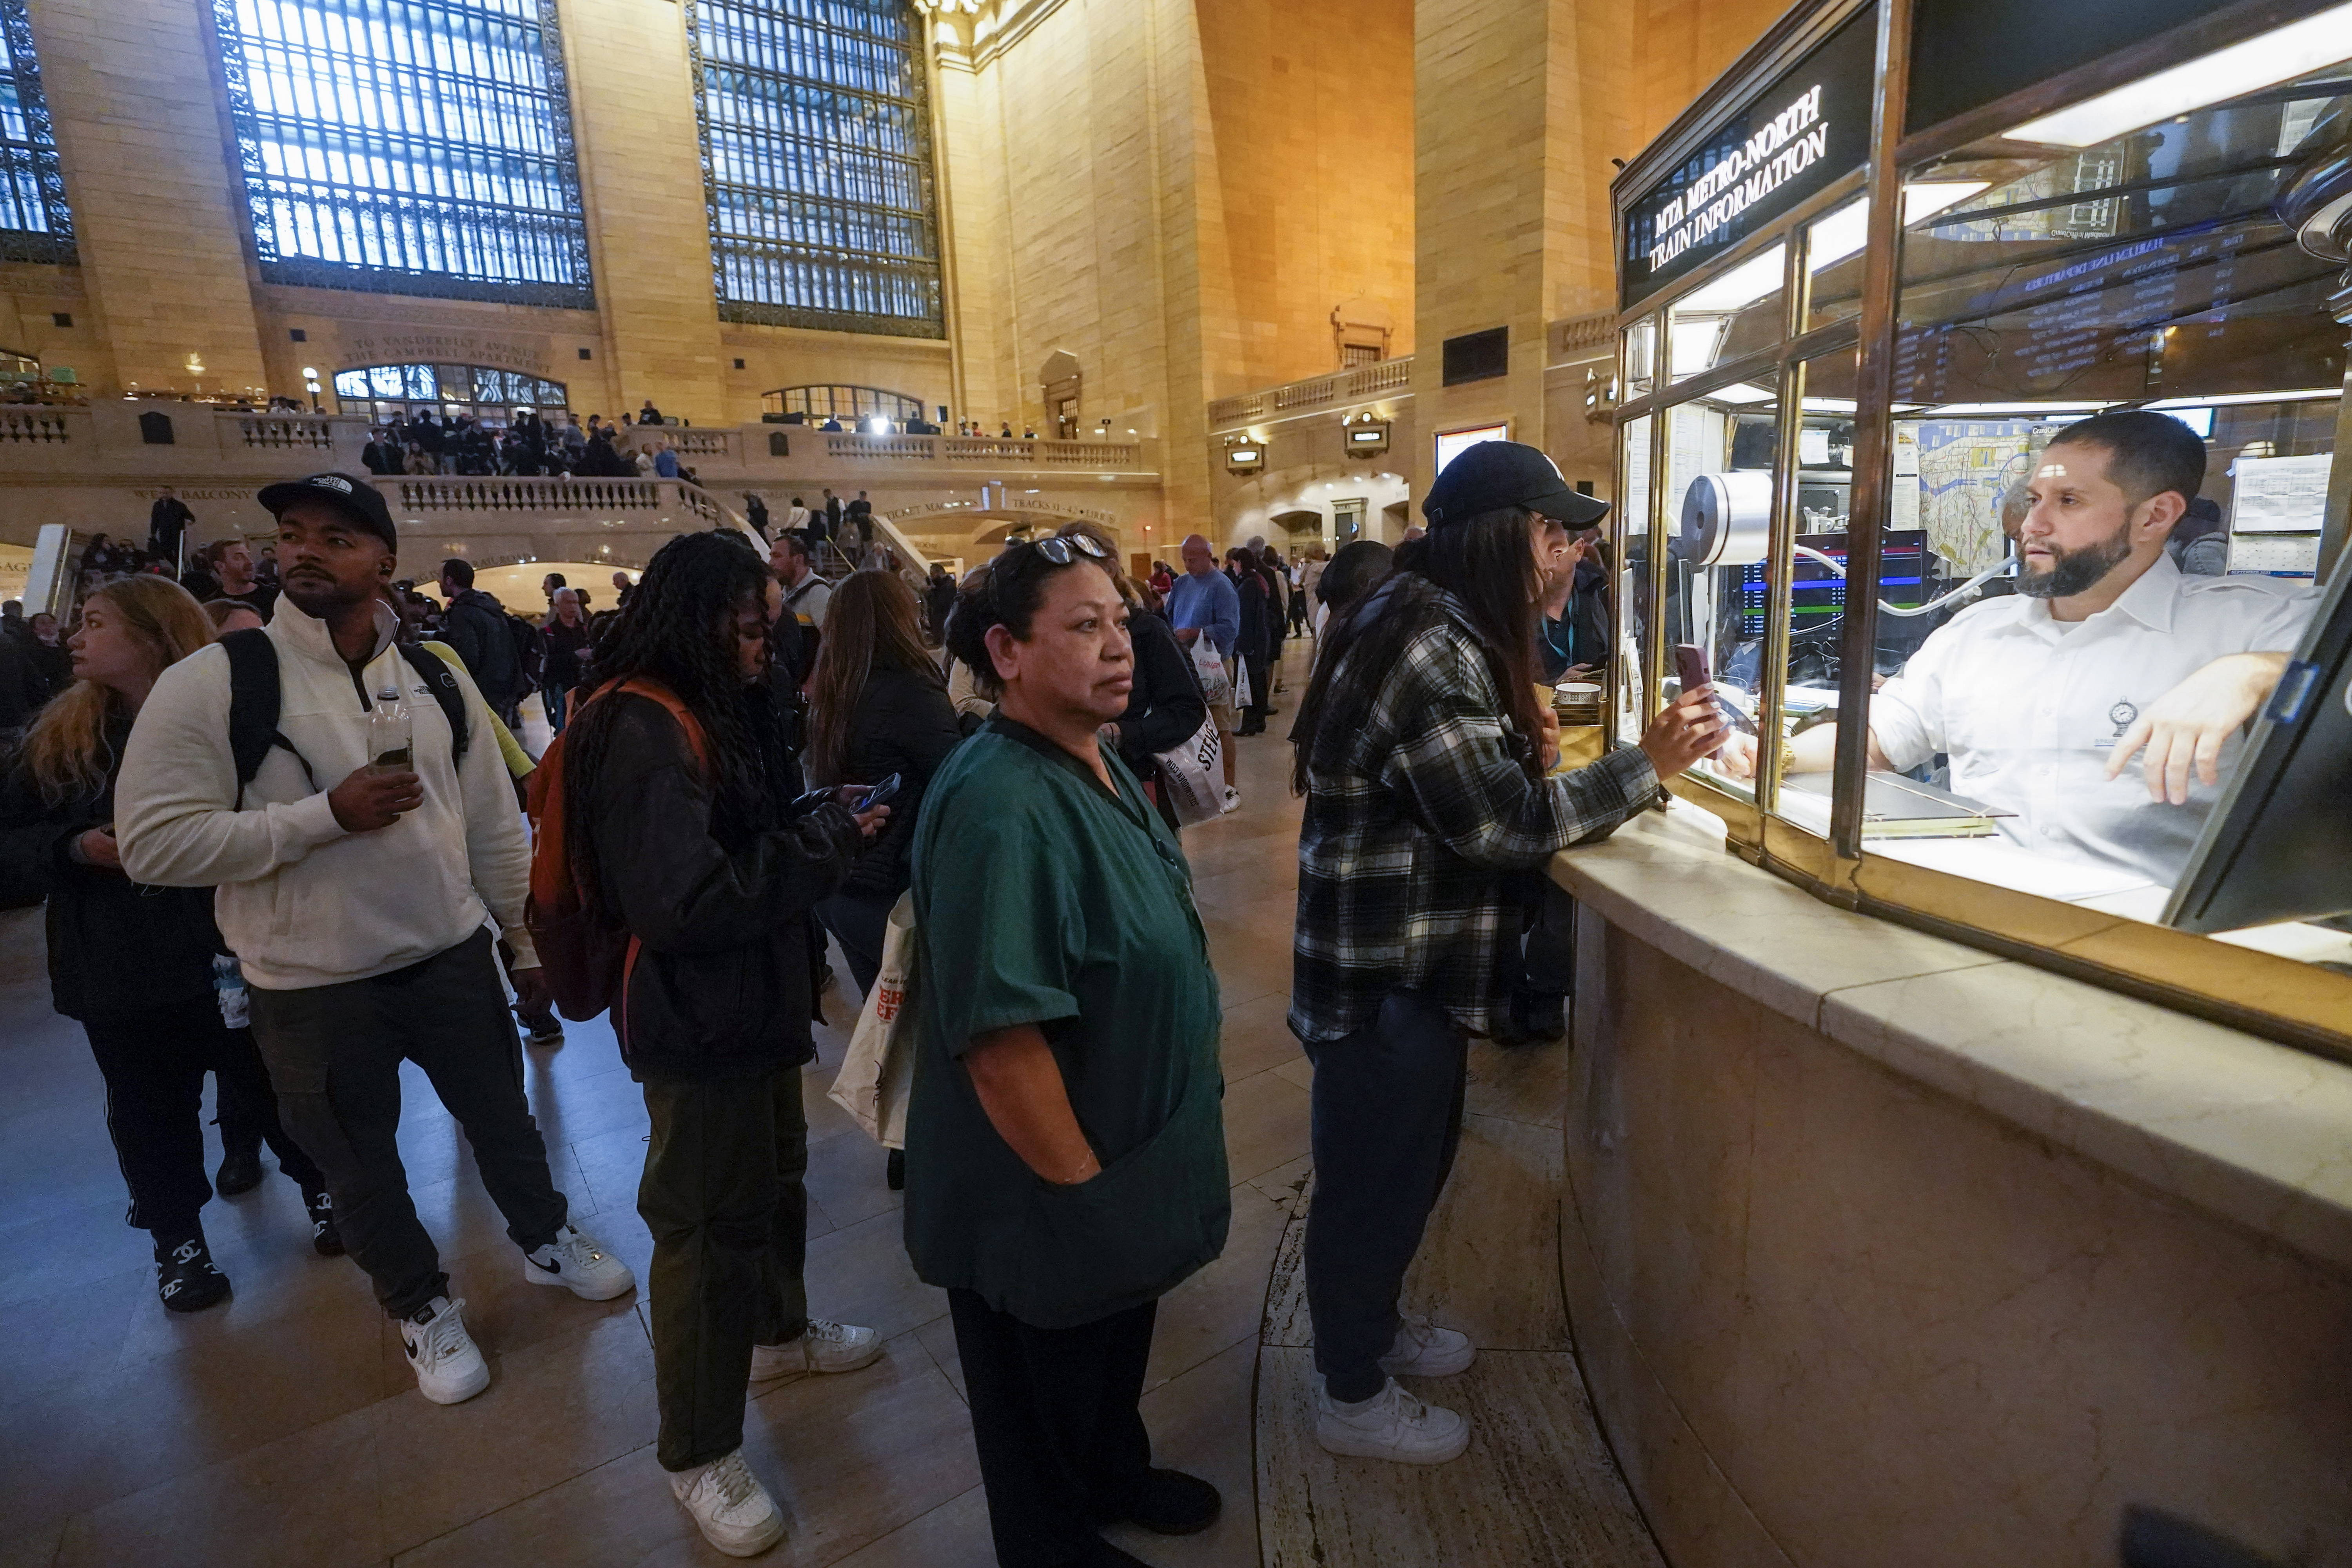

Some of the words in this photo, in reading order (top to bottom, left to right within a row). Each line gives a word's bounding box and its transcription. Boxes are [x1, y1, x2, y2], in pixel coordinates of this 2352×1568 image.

[1655, 196, 1683, 238] MTA
[1686, 84, 1821, 215] METRO-NORTH
[1650, 223, 1692, 272] TRAIN
[1693, 122, 1829, 243] INFORMATION
[181, 490, 250, 499] BALCONY
[1013, 499, 1050, 509] TRACKS
[1086, 509, 1105, 521] LIRR
[884, 505, 921, 521] TICKET
[1198, 723, 1220, 771] STEVE
